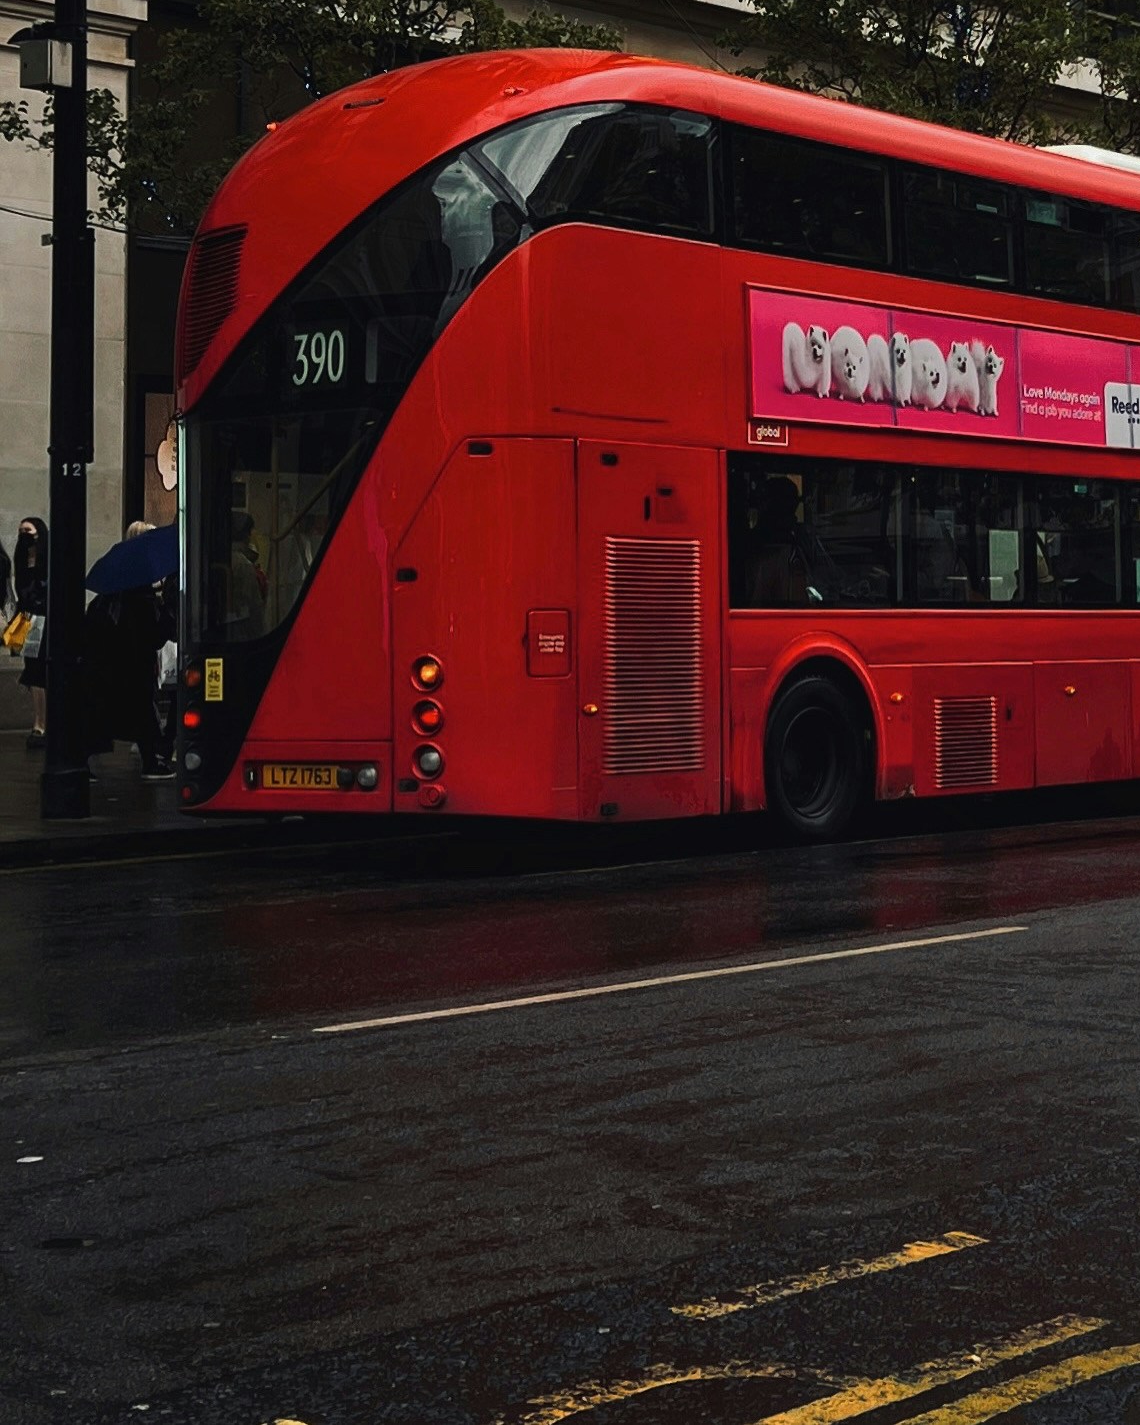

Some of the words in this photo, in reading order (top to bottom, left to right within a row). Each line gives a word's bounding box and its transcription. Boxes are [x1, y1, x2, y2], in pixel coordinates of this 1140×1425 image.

[292, 329, 345, 386] 390
[1023, 384, 1043, 398] Love
[1044, 386, 1078, 406] Mondays
[1079, 392, 1100, 408] again
[1020, 400, 1037, 415] Find
[1045, 403, 1058, 419] job
[1058, 407, 1072, 420] you
[756, 425, 781, 441] global
